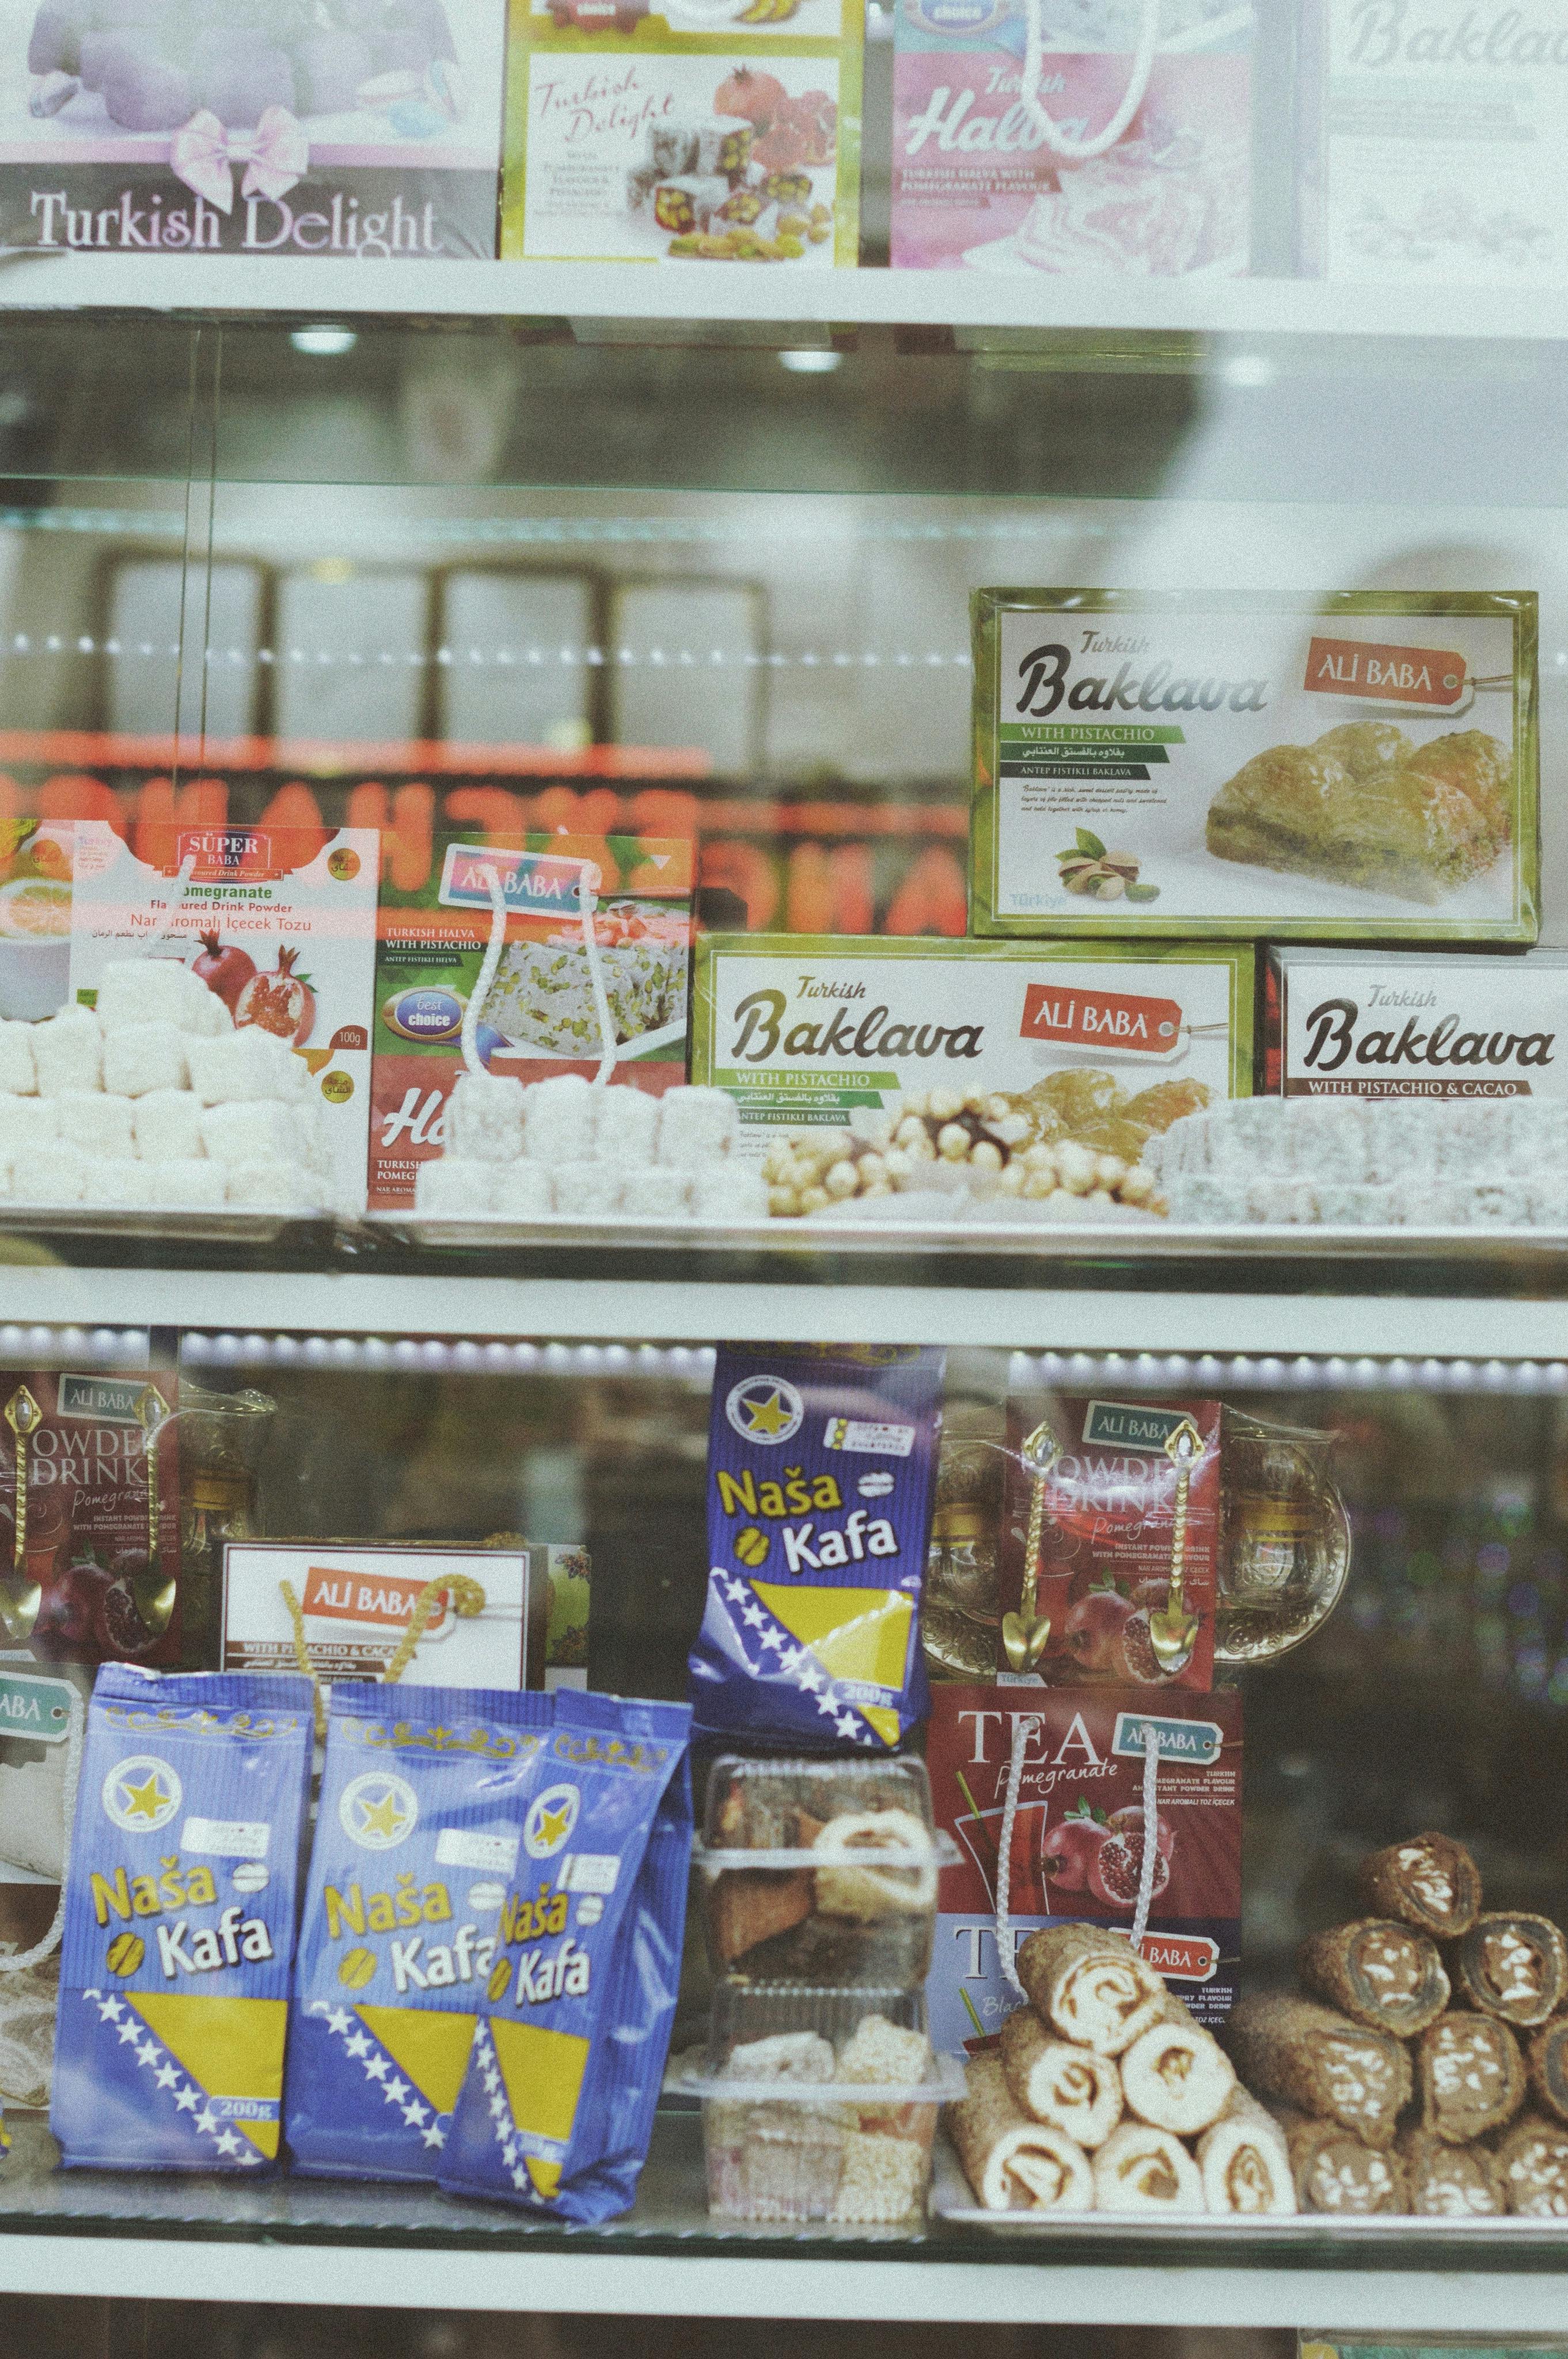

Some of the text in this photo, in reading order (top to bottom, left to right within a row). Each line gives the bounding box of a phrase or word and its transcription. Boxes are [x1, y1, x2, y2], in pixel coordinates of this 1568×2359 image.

[1349, 0, 1568, 67] Bakla
[985, 66, 1066, 94] Turish
[32, 190, 447, 259] Turkish Delight
[1080, 630, 1151, 654] Turkish
[1016, 643, 1268, 718] Baklava
[1366, 659, 1432, 691] BABA
[1021, 726, 1156, 742] WITH PISTACHIO
[1021, 767, 1132, 776] ANTEP FISTIKLI BAKLAVA
[188, 831, 259, 854] SÜPER
[207, 854, 241, 866] BABA
[184, 886, 272, 900] megranate
[462, 866, 562, 900] AL BABA
[150, 900, 293, 914] Flaured Drink Powder
[130, 913, 312, 932] Nar romalı İçecek Tozu
[387, 927, 475, 938] TURKISH HALVA
[386, 940, 481, 950] WITH PISTACHIO
[796, 976, 866, 1000] Turkish
[1367, 984, 1437, 1008] Turkish
[408, 1012, 451, 1027] choice
[731, 988, 985, 1063] Baklava
[1033, 1000, 1148, 1039] ALİ BABA
[340, 1031, 361, 1046] 100g
[1303, 997, 1556, 1072] Baklava
[735, 1072, 871, 1087] WITH PISTACHIO
[1308, 1080, 1517, 1097] WITH PISTACHIO & CACAO
[768, 1113, 804, 1121] FISTIKLI
[807, 1114, 846, 1122] BAKLAVA
[97, 1391, 135, 1411] BABA
[1129, 1419, 1170, 1440] BABA
[32, 1429, 149, 1458] OWDE
[31, 1457, 150, 1487] DRINK
[1053, 1455, 1175, 1485] OWDE
[716, 1465, 842, 1518] Naša
[782, 1509, 898, 1574] Kafa
[1115, 1552, 1171, 1560] POMEGRANAT
[357, 1586, 416, 1616] BABA
[244, 1643, 278, 1654] WITH
[282, 1644, 348, 1656] PIACHIO
[362, 1645, 396, 1657] CACA
[0, 1693, 41, 1721] ABA
[958, 1711, 1108, 1766] TEA
[1156, 1731, 1197, 1751] BABA
[993, 1757, 1118, 1799] Pmegranate
[89, 1855, 217, 1926] Naša
[324, 1873, 453, 1940] Naša
[500, 1883, 568, 1945] Naša
[157, 1906, 273, 1978] Kafa
[390, 1924, 496, 1993] Kafa
[1149, 1948, 1192, 1967] BABA
[515, 1937, 590, 2008] Kafa
[982, 1996, 1019, 2017] Blac
[220, 2100, 272, 2120] 200g
